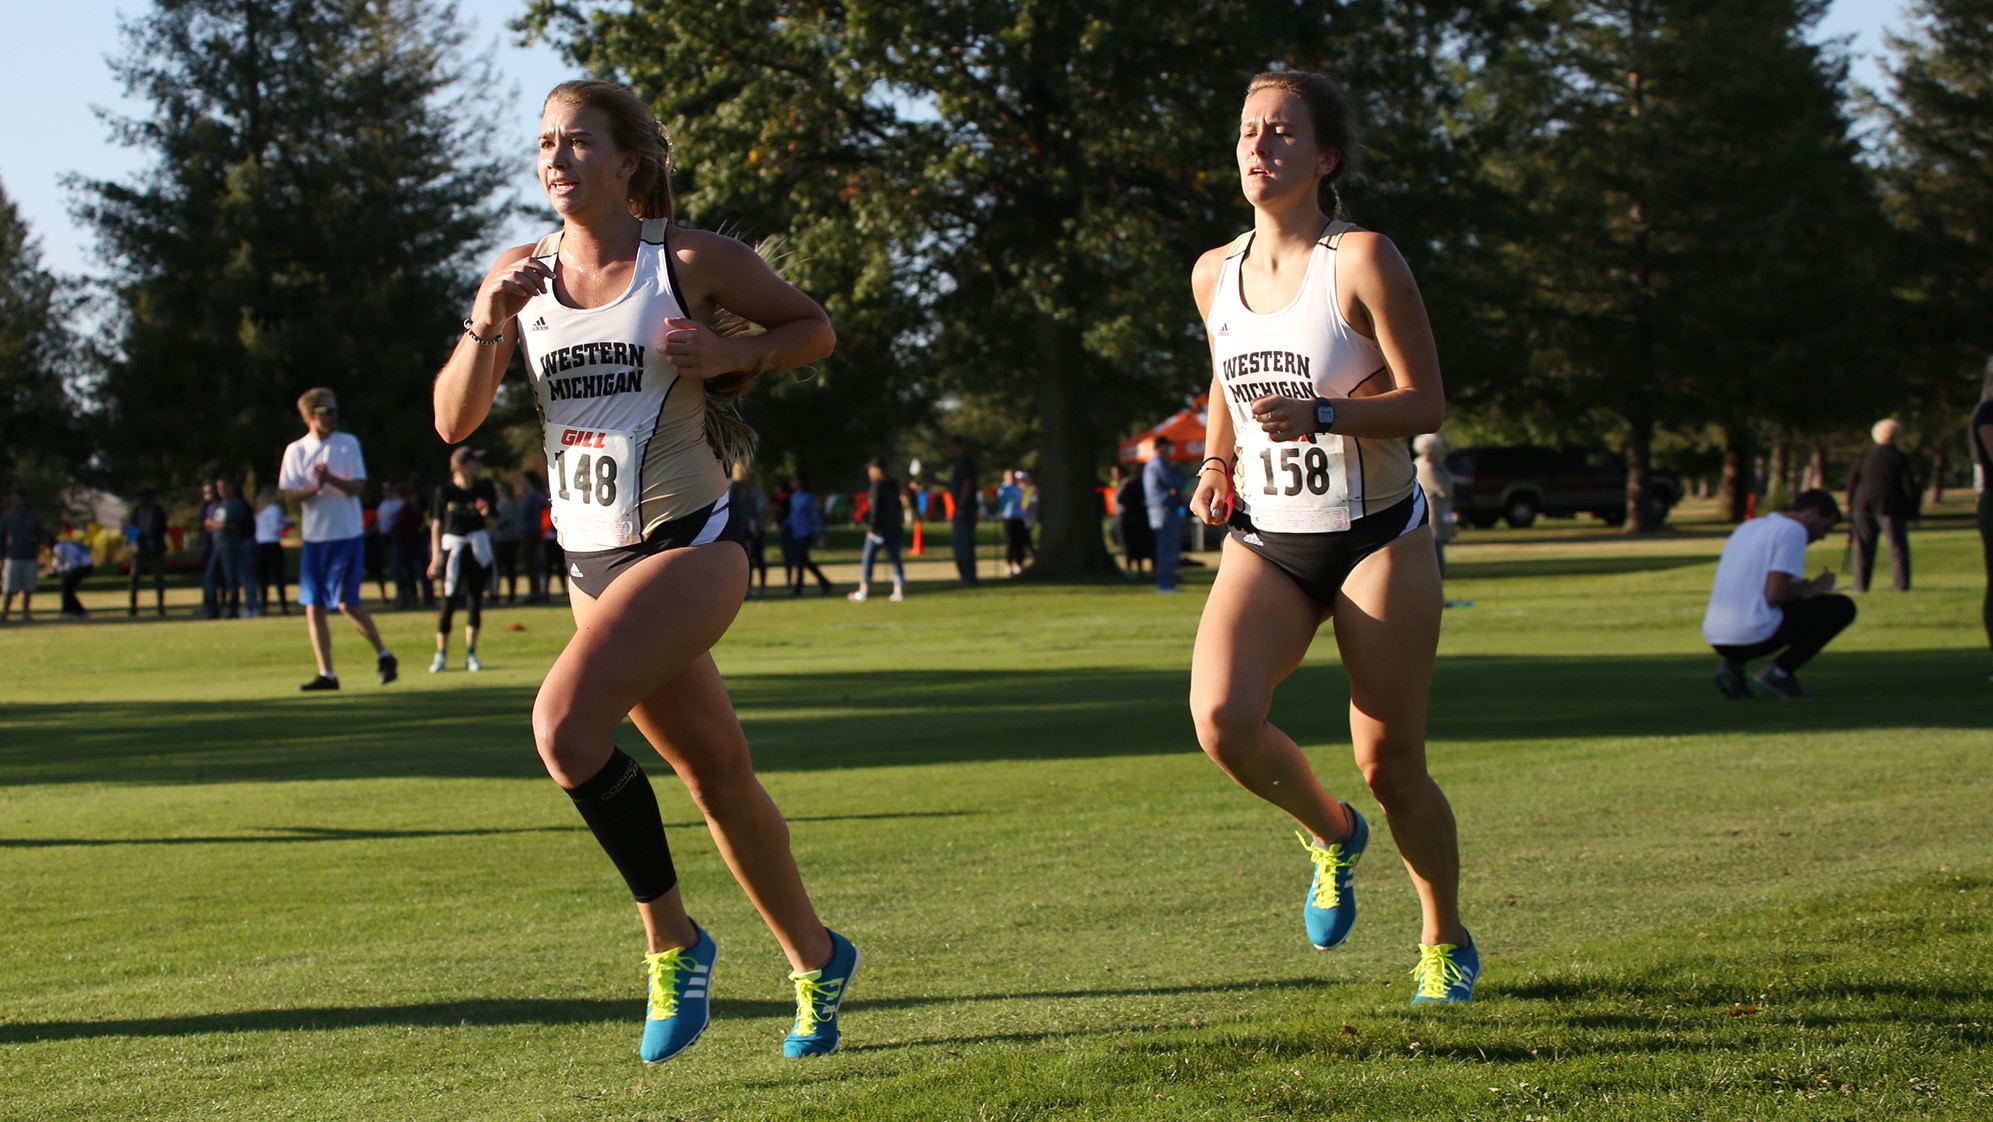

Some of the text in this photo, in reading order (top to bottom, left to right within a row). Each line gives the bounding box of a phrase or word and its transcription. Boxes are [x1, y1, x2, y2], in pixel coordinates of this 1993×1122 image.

[540, 342, 645, 378] WESTERN
[1223, 351, 1311, 381] WESTERN
[547, 369, 644, 401] MICHIGAN
[1228, 381, 1317, 403] MICHIGAN
[561, 429, 606, 449] GILL
[554, 450, 617, 507] 148
[1259, 447, 1330, 497] 158
